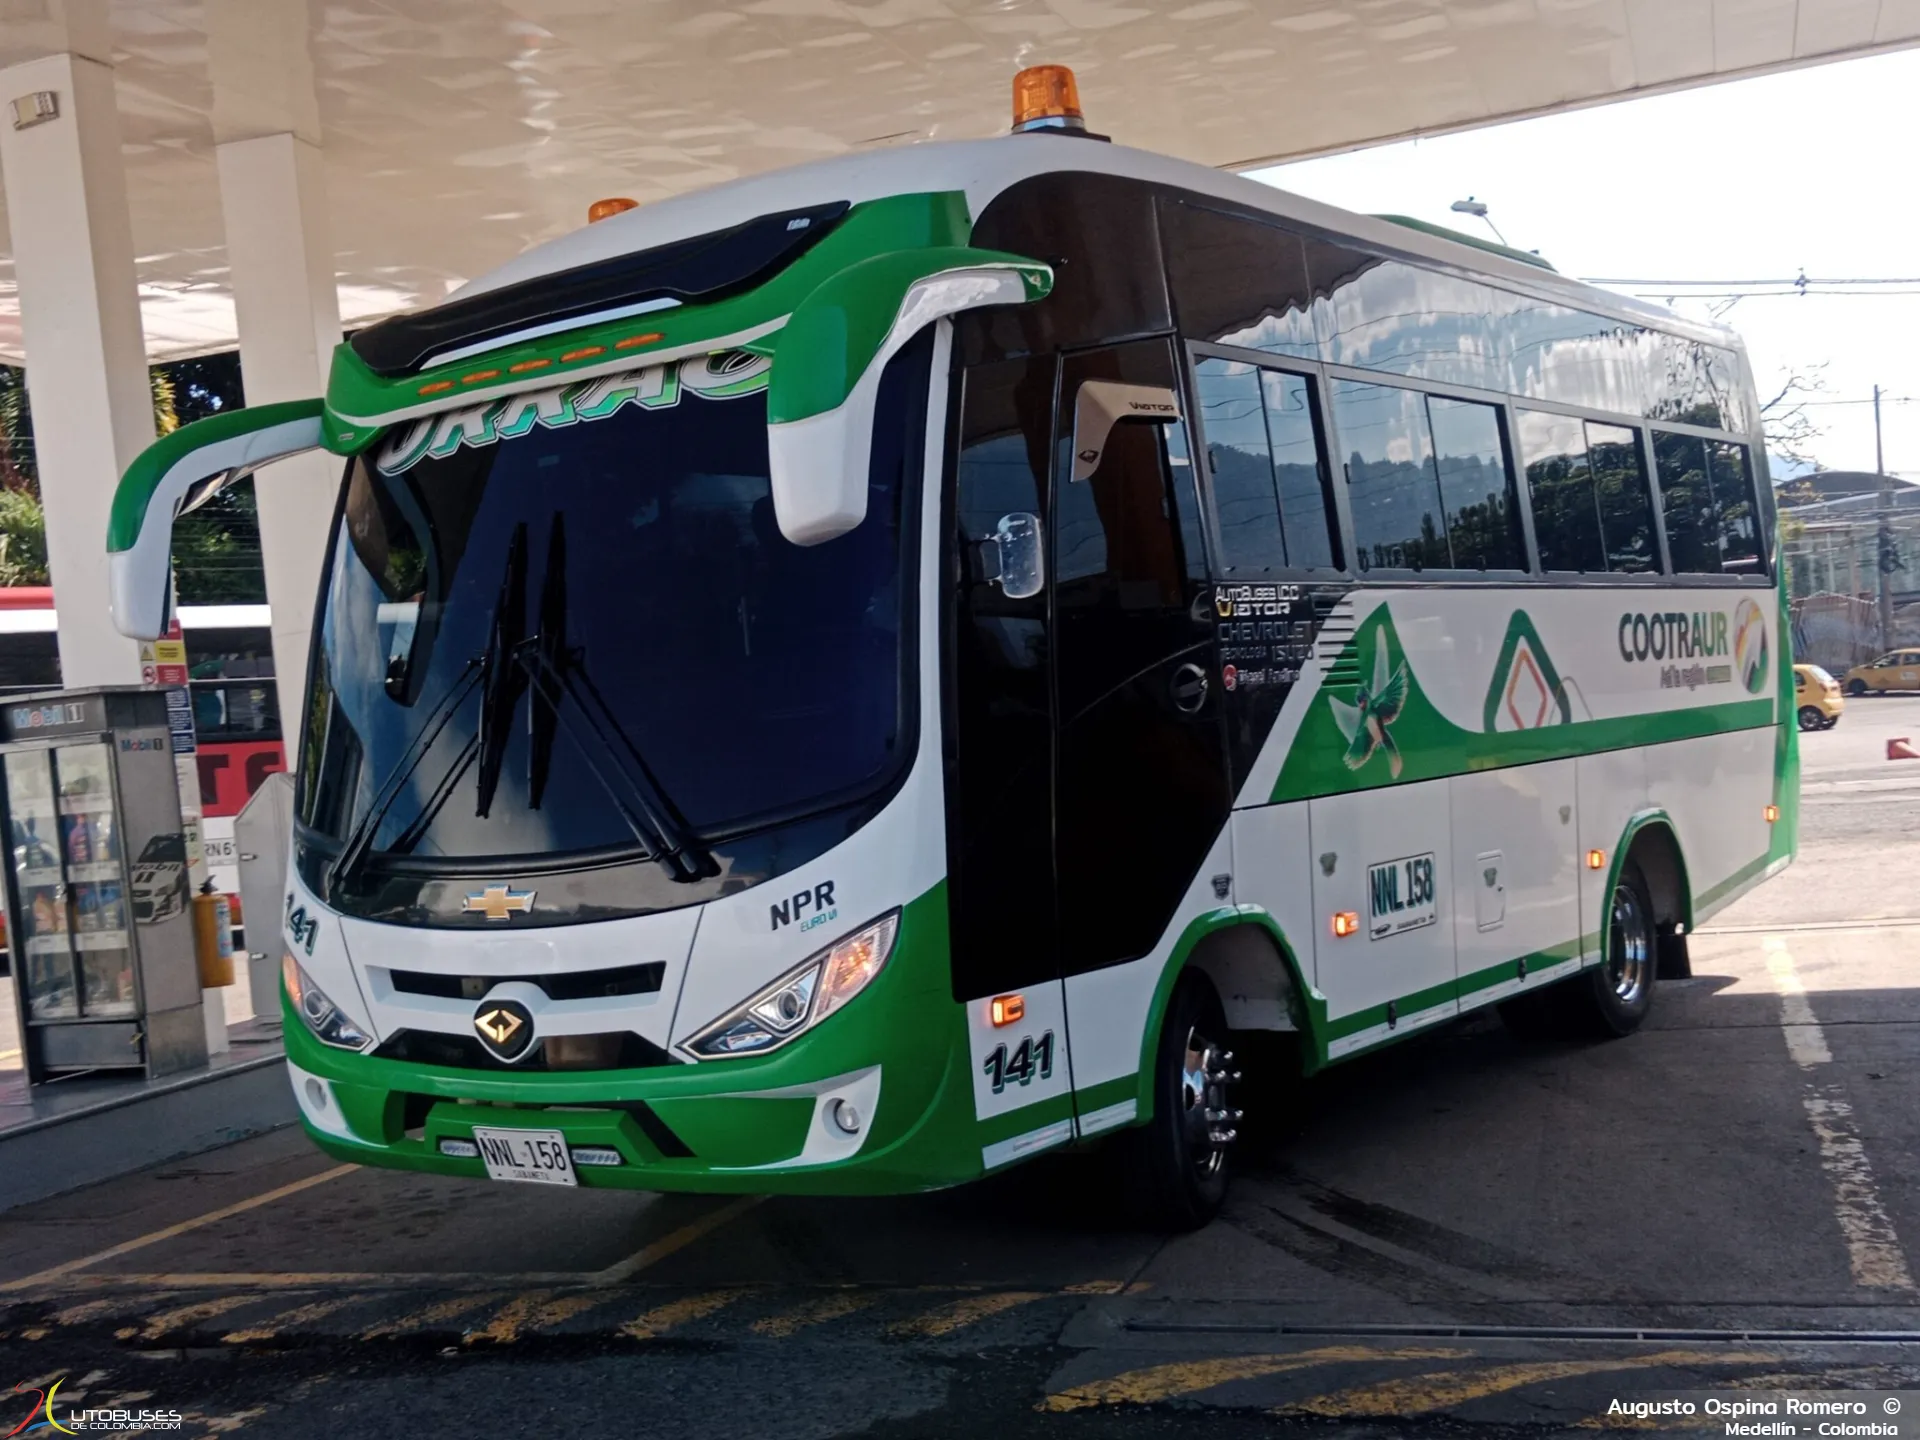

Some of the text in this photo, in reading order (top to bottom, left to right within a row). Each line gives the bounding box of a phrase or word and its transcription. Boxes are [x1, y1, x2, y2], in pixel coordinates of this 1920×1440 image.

[1618, 612, 1728, 662] COOTRAUR
[12, 704, 64, 729] Mobil
[770, 880, 835, 931] NPR
[1371, 858, 1433, 918] NNL 158
[285, 892, 319, 957] 141
[984, 1029, 1055, 1094] 141
[480, 1137, 567, 1171] NNL 158
